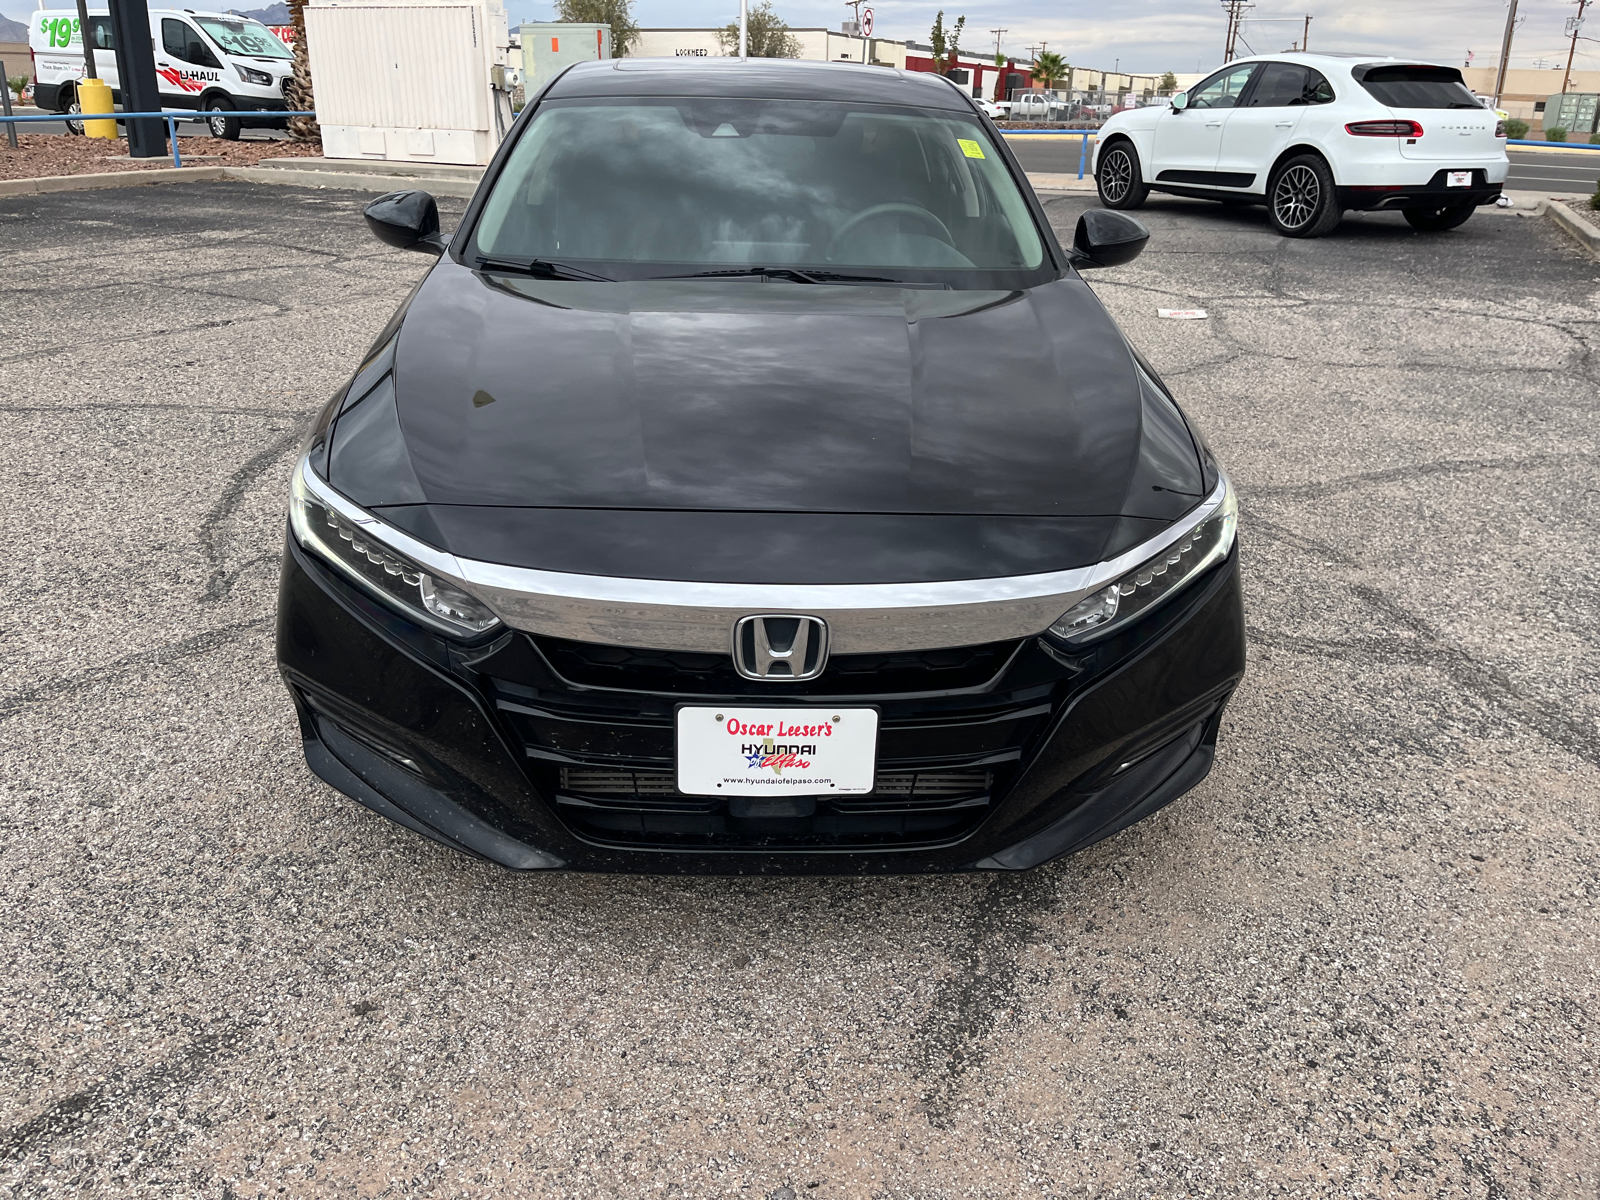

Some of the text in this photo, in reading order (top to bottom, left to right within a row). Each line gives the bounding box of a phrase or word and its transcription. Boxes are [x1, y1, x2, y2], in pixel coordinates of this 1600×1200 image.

[675, 48, 708, 57] LOCKHEED
[726, 718, 832, 737] Oscar Leeser's
[741, 743, 816, 755] HYUNDAI
[750, 753, 810, 769] of El Paso
[723, 777, 832, 785] www.hyundaiofelpaso.com
